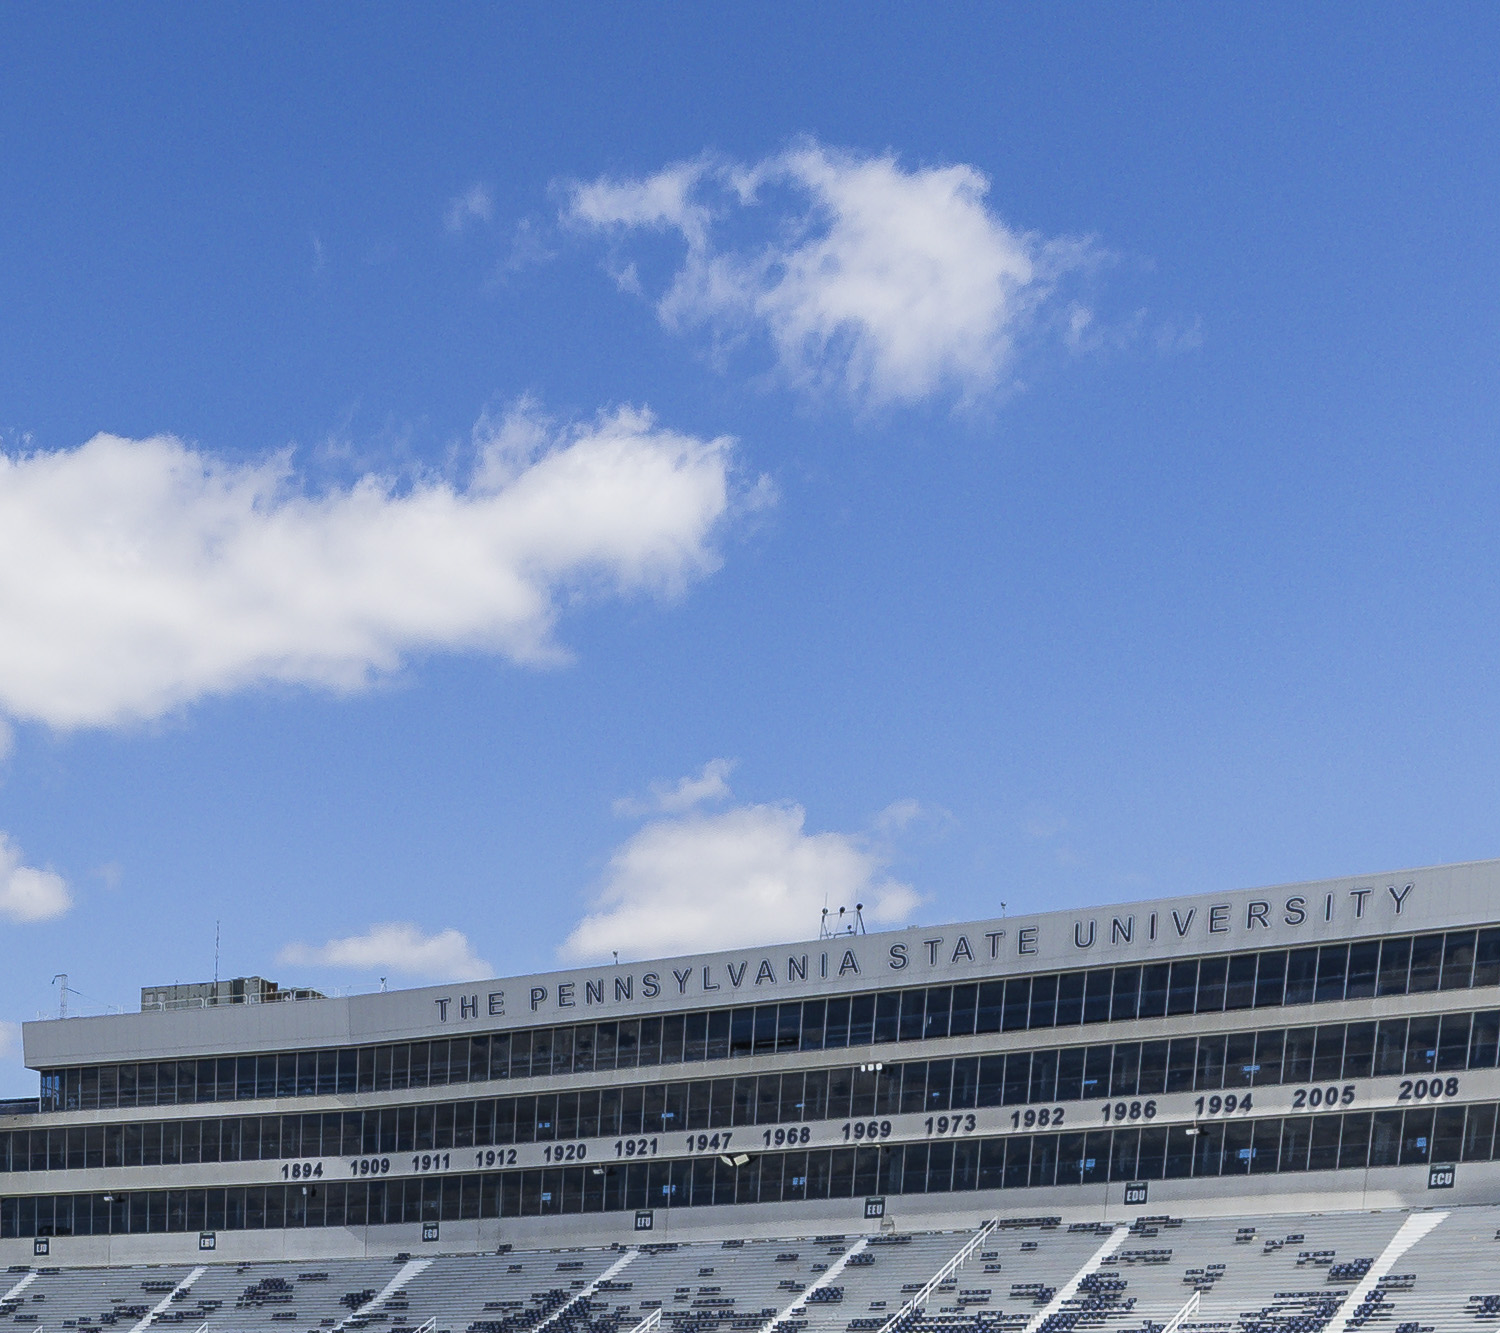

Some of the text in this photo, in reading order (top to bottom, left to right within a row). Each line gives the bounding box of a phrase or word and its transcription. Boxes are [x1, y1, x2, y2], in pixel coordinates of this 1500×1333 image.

[435, 880, 1415, 1022] THE PENNSYLVANIA STATE UNIVERSITY
[281, 1162, 324, 1180] 1894
[350, 1158, 390, 1177] 1909
[412, 1153, 451, 1172] 1911
[476, 1149, 518, 1168] 1912
[543, 1143, 587, 1163] 1920
[614, 1138, 659, 1157] 1921
[686, 1132, 733, 1153] 1947
[762, 1127, 811, 1148] 1968
[841, 1120, 892, 1141] 1969
[924, 1114, 977, 1135] 1973
[1010, 1107, 1066, 1128] 1982
[1101, 1101, 1157, 1123] 1986
[1194, 1093, 1253, 1116] 1994
[1292, 1085, 1356, 1109] 2005
[1397, 1077, 1459, 1101] 2008
[1431, 1173, 1452, 1185] ECU
[1126, 1189, 1146, 1202] EDU
[867, 1204, 883, 1215] EEU
